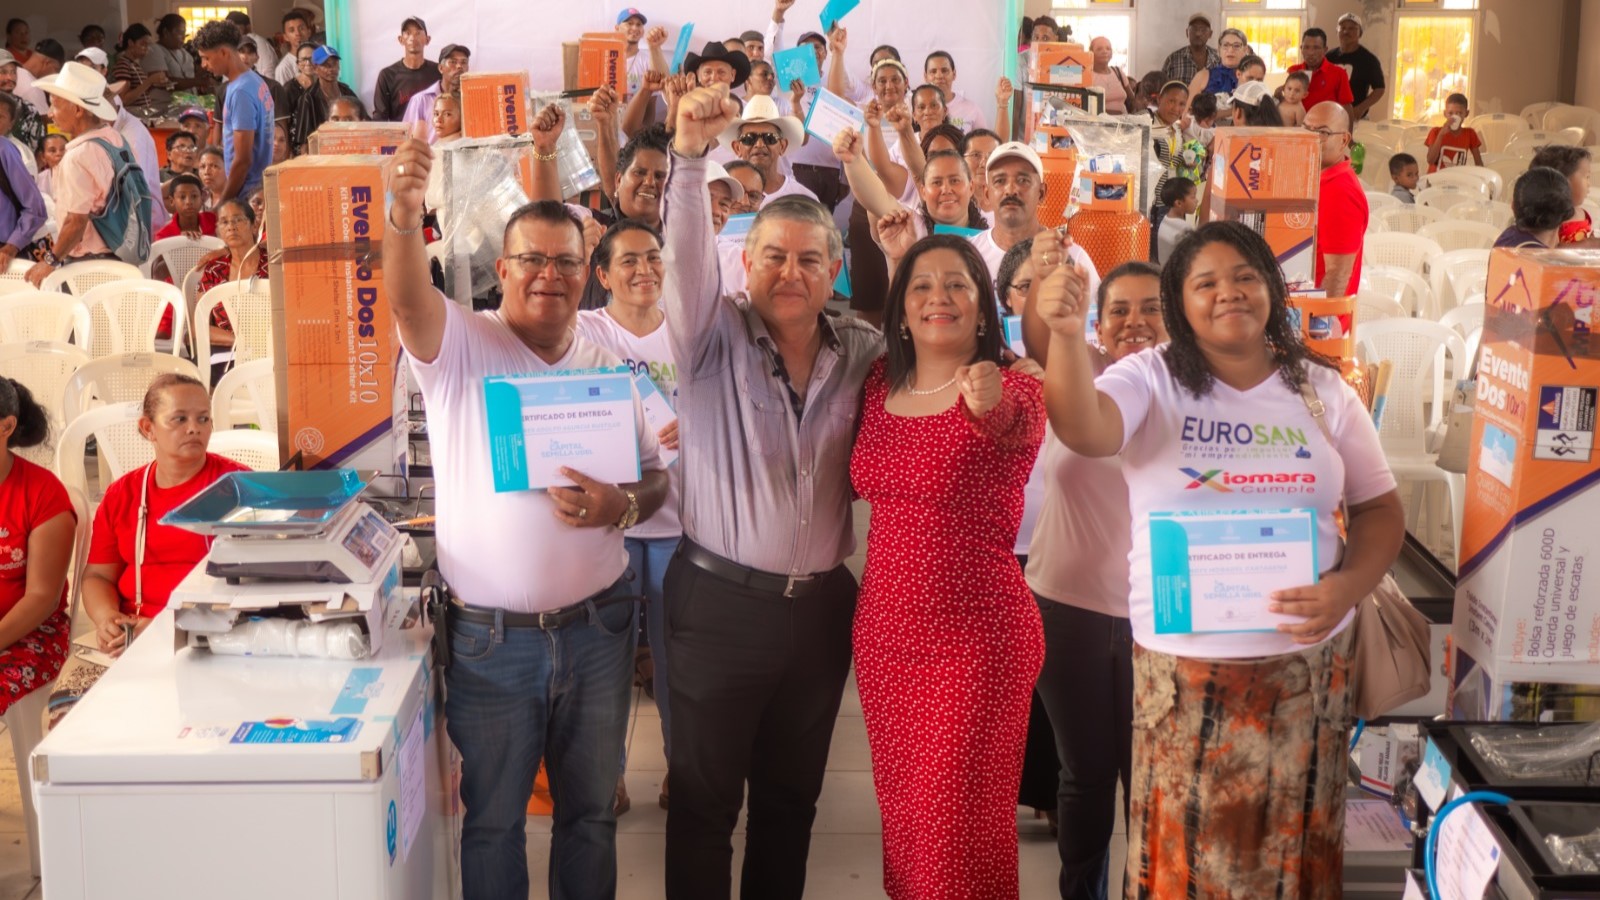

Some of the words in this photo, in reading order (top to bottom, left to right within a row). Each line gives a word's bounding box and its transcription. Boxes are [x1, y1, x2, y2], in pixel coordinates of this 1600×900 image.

[1248, 145, 1262, 190] IMPACT
[340, 187, 349, 201] Kit
[341, 202, 349, 216] De
[357, 287, 378, 338] Dos
[358, 340, 379, 404] 10x10
[622, 358, 677, 382] ROSA
[349, 390, 358, 404] Kit
[1477, 374, 1508, 410] Dos
[1552, 392, 1562, 424] WARNING
[521, 412, 565, 422] ERTIFICADO
[567, 411, 577, 419] DE
[578, 409, 613, 418] ENTREGA
[1181, 415, 1308, 447] EUROSAN
[549, 442, 584, 451] CAPITAL
[1178, 467, 1316, 493] Xiomara
[1240, 485, 1315, 494] Cumple
[1187, 552, 1232, 562] RTIFICADO
[1235, 552, 1247, 560] DE
[1247, 551, 1287, 560] ENTREGA
[1541, 527, 1555, 561] 600D
[1214, 584, 1251, 592] CAPITAL
[1533, 564, 1551, 622] reforzada
[1542, 616, 1559, 658] Cuerda
[1551, 557, 1567, 612] universal
[1559, 545, 1570, 554] y
[1565, 604, 1577, 620] de
[1510, 617, 1527, 664] Incluye:
[1527, 625, 1543, 658] Bolsa
[1561, 625, 1576, 658] juego
